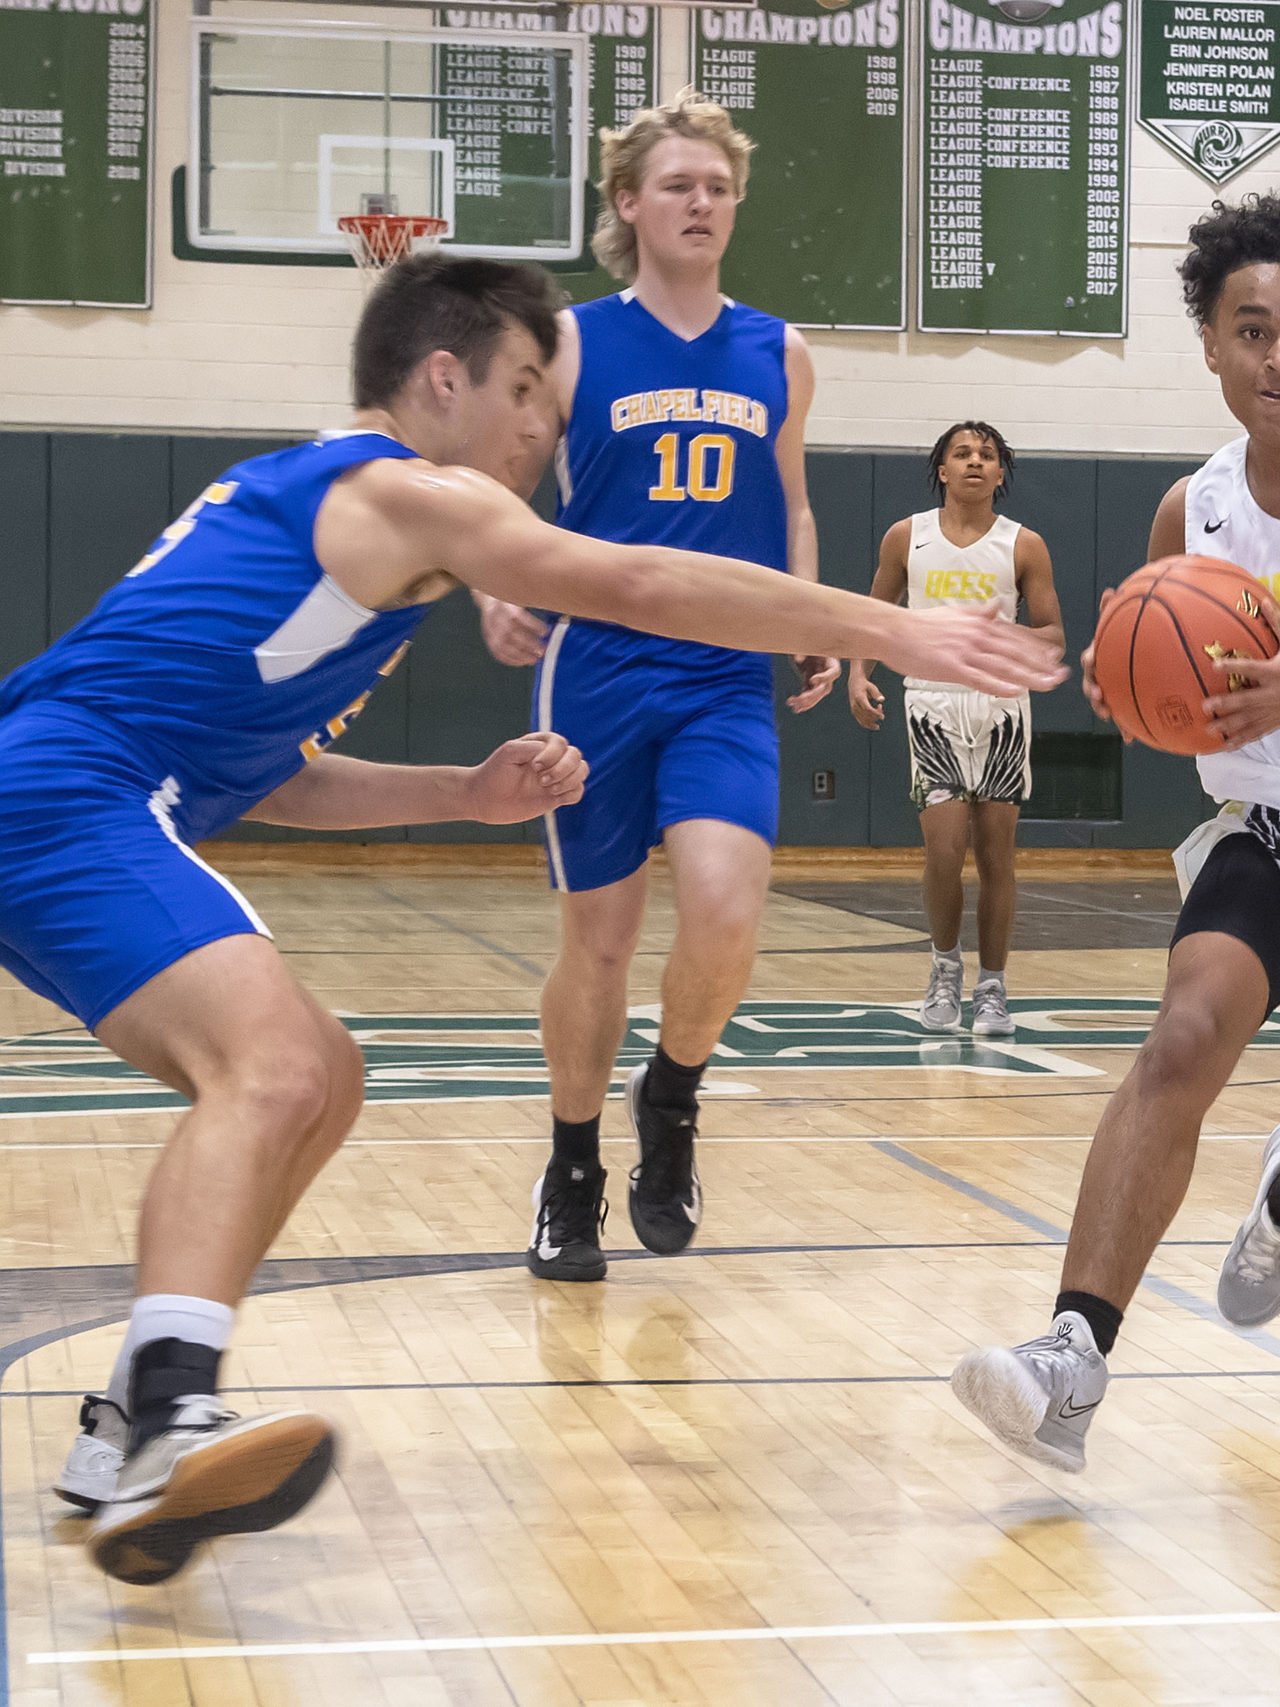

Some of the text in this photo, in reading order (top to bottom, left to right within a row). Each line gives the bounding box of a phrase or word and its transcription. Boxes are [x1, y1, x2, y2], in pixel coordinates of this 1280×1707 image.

[702, 1, 899, 48] CHAMPIONS
[1174, 7, 1265, 23] NOEL FOSTER
[929, 0, 1123, 58] CHAMPIONS
[1164, 25, 1275, 42] LAUREN MALLOR
[615, 45, 646, 59] 1980
[703, 49, 897, 69] LEAGUE 1988
[1170, 44, 1268, 61] ERIN JOHNSON
[447, 53, 643, 75] LEAGUE-CONFEE 1981
[930, 58, 1120, 79] LEAGUE 1969
[1163, 62, 1275, 80] JENNIFER POLAN
[447, 69, 646, 91] LEAGUE-CONFEE 1982
[703, 65, 897, 85] LEAGUE 1998
[930, 74, 1120, 95] LEAGUE-CONFERENCE 1987
[703, 80, 899, 101] LEAGUE 2006
[1166, 81, 1271, 98] KRISTEN POLAN
[615, 93, 647, 107] 1987
[867, 102, 896, 116] 2019
[930, 90, 1118, 110] LEAGUE 1988
[1169, 98, 1269, 114] ISABELLE SMITH
[447, 103, 594, 122] LEAGUE-CONFEE
[930, 105, 1118, 126] LEAGUE-CONFERENCE 1989
[447, 117, 594, 137] LEAGUE-CONFEE
[930, 121, 1118, 141] LEAGUE-CONFERENCE 1990
[930, 137, 1118, 157] LEAGUE-CONFERENCE 1993
[455, 150, 501, 166] EAGUE
[930, 152, 1118, 173] LEAGUE-CONFERENCE 1994
[455, 166, 501, 182] EAGUE
[930, 168, 1118, 188] LEAGUE 1998
[455, 181, 501, 197] EAGUE
[930, 184, 1120, 204] LEAGUE 2002
[930, 199, 1120, 219] LEAGUE 2003
[930, 215, 1118, 234] LEAGUE 2014
[930, 231, 1118, 249] LEAGUE 2015
[930, 246, 1118, 266] LEAGUE 2015
[931, 260, 983, 275] LEAGUE
[1087, 265, 1118, 280] 2016
[931, 275, 1118, 295] LEAGUE 2017
[649, 433, 736, 502] 10
[925, 570, 997, 601] BEES
